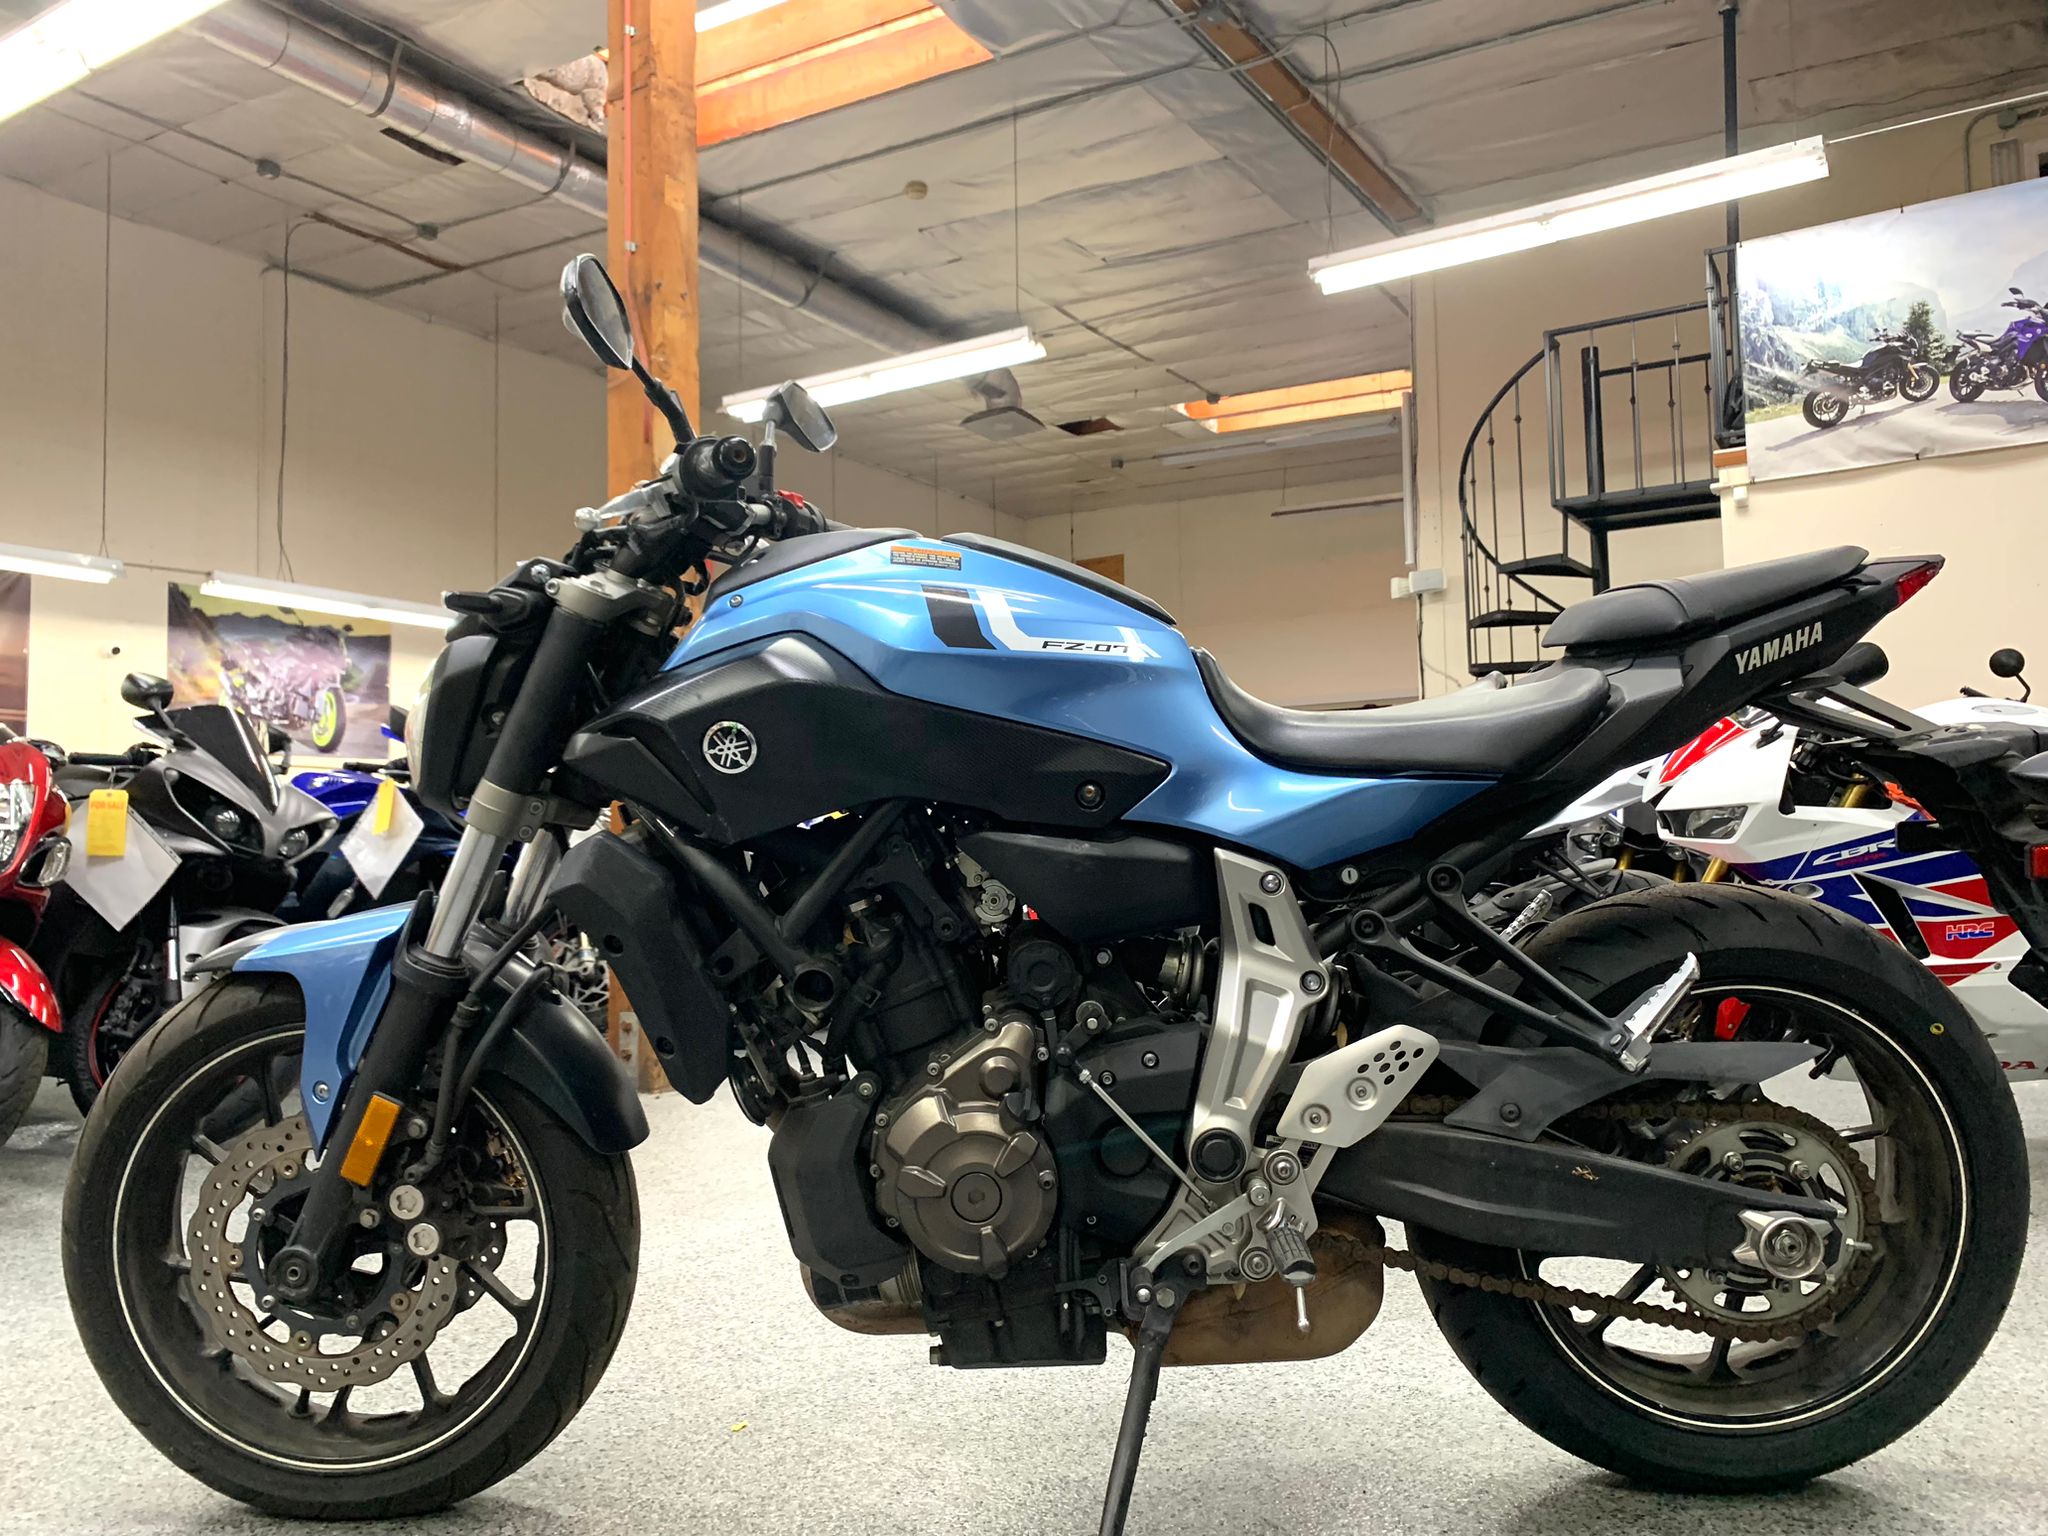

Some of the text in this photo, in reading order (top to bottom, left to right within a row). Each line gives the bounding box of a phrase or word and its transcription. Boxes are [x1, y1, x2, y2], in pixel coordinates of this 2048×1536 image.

[1042, 640, 1129, 654] FZ-07
[1735, 621, 1823, 675] YAMAHA
[90, 801, 106, 810] FOR
[1812, 838, 1897, 866] CBR
[1946, 921, 1995, 941] HRC
